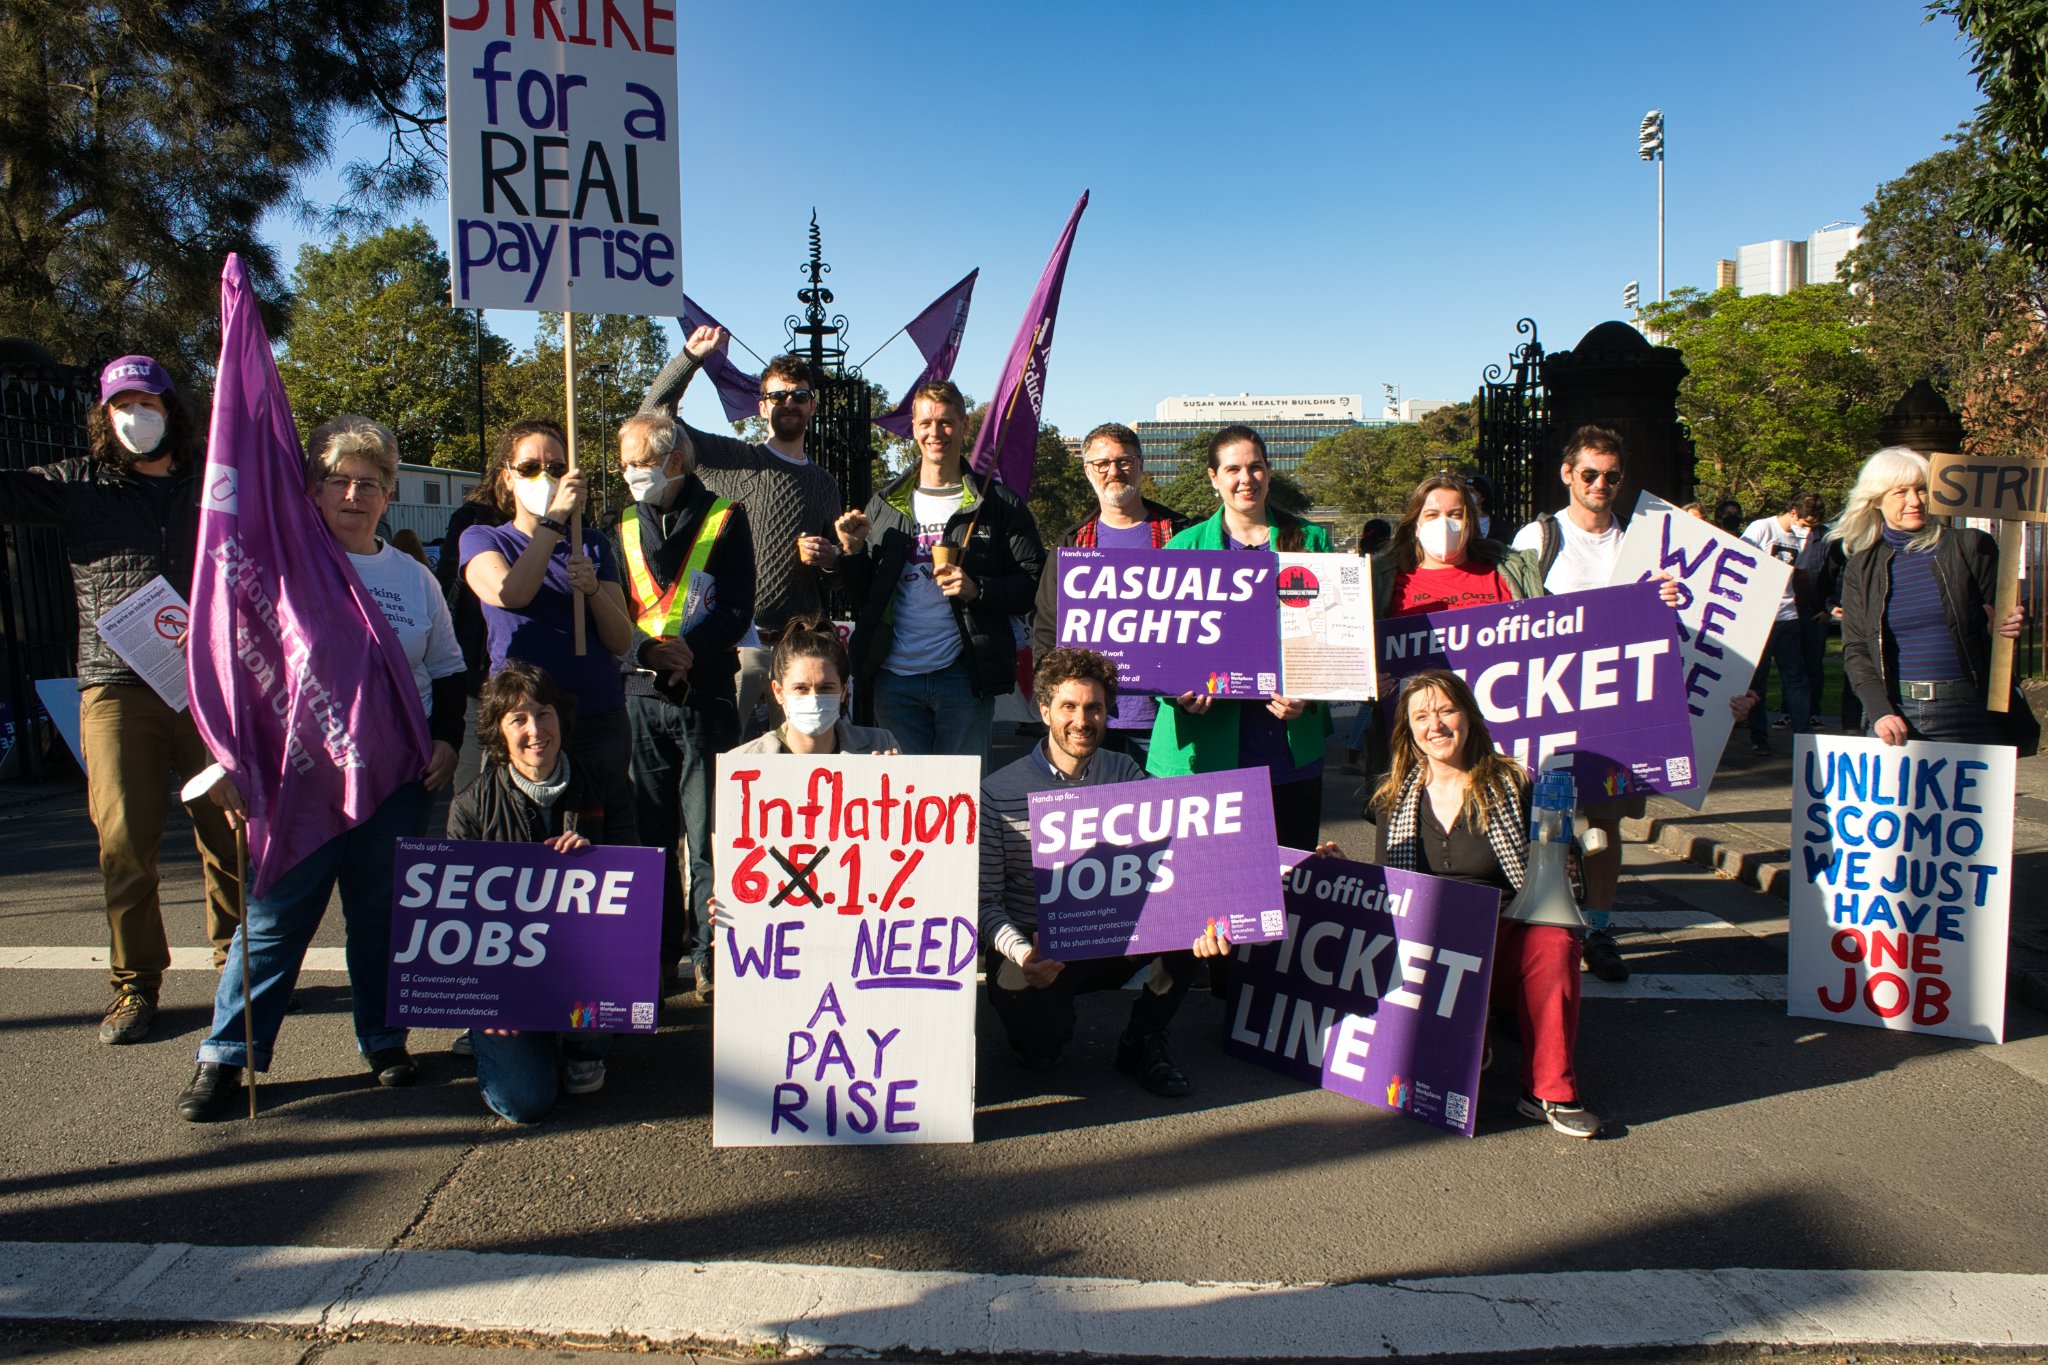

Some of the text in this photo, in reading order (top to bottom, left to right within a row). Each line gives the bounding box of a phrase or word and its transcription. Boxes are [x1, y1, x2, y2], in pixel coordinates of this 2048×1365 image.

[473, 40, 666, 141] for a
[481, 130, 659, 226] REAL
[457, 219, 674, 303] pay rise
[107, 364, 150, 384] NTEU
[1025, 355, 1041, 421] Educa
[1933, 464, 2048, 513] STRI
[1660, 513, 1758, 603] WE
[369, 587, 401, 602] rking
[386, 603, 405, 612] are
[1063, 565, 1269, 602] CASUALS'
[1413, 593, 1431, 602] NO
[384, 613, 415, 627] ning
[1061, 608, 1222, 645] RIGHTS
[1385, 605, 1584, 661] NTEU official
[1117, 662, 1130, 670] ghts
[1452, 638, 1670, 723] CKET
[1032, 794, 1054, 803] Hands
[1054, 794, 1064, 802] up
[1805, 750, 1989, 814] UNLIKE
[730, 768, 978, 849] Inflation
[1037, 791, 1243, 854] SECURE
[1804, 802, 1983, 857] SCOMO
[400, 841, 425, 850] Hands
[399, 863, 634, 915] SECURE
[1039, 850, 1175, 905] JOBS
[1280, 864, 1413, 918] EU official
[1802, 845, 1998, 907] WE JUST
[1058, 907, 1117, 919] Conversion rights
[1059, 920, 1138, 933] Restructure protections
[1834, 893, 1966, 942] HAVE
[393, 918, 550, 968] JOBS
[727, 916, 978, 979] WE NEED
[1072, 938, 1091, 947] sham
[1092, 934, 1139, 945] redundancies
[1831, 927, 1944, 975] ONE
[412, 974, 479, 986] Conversion rights
[1237, 913, 1483, 1019] ICKET
[411, 989, 499, 1001] Restructure protections
[411, 1006, 498, 1016] No sham redundancies
[807, 982, 846, 1028] A
[1817, 967, 1952, 1026] JOB
[786, 1028, 900, 1082] PAY
[1230, 983, 1377, 1083] LINE
[771, 1079, 920, 1136] RISE
[1446, 1119, 1458, 1127] JOIN
